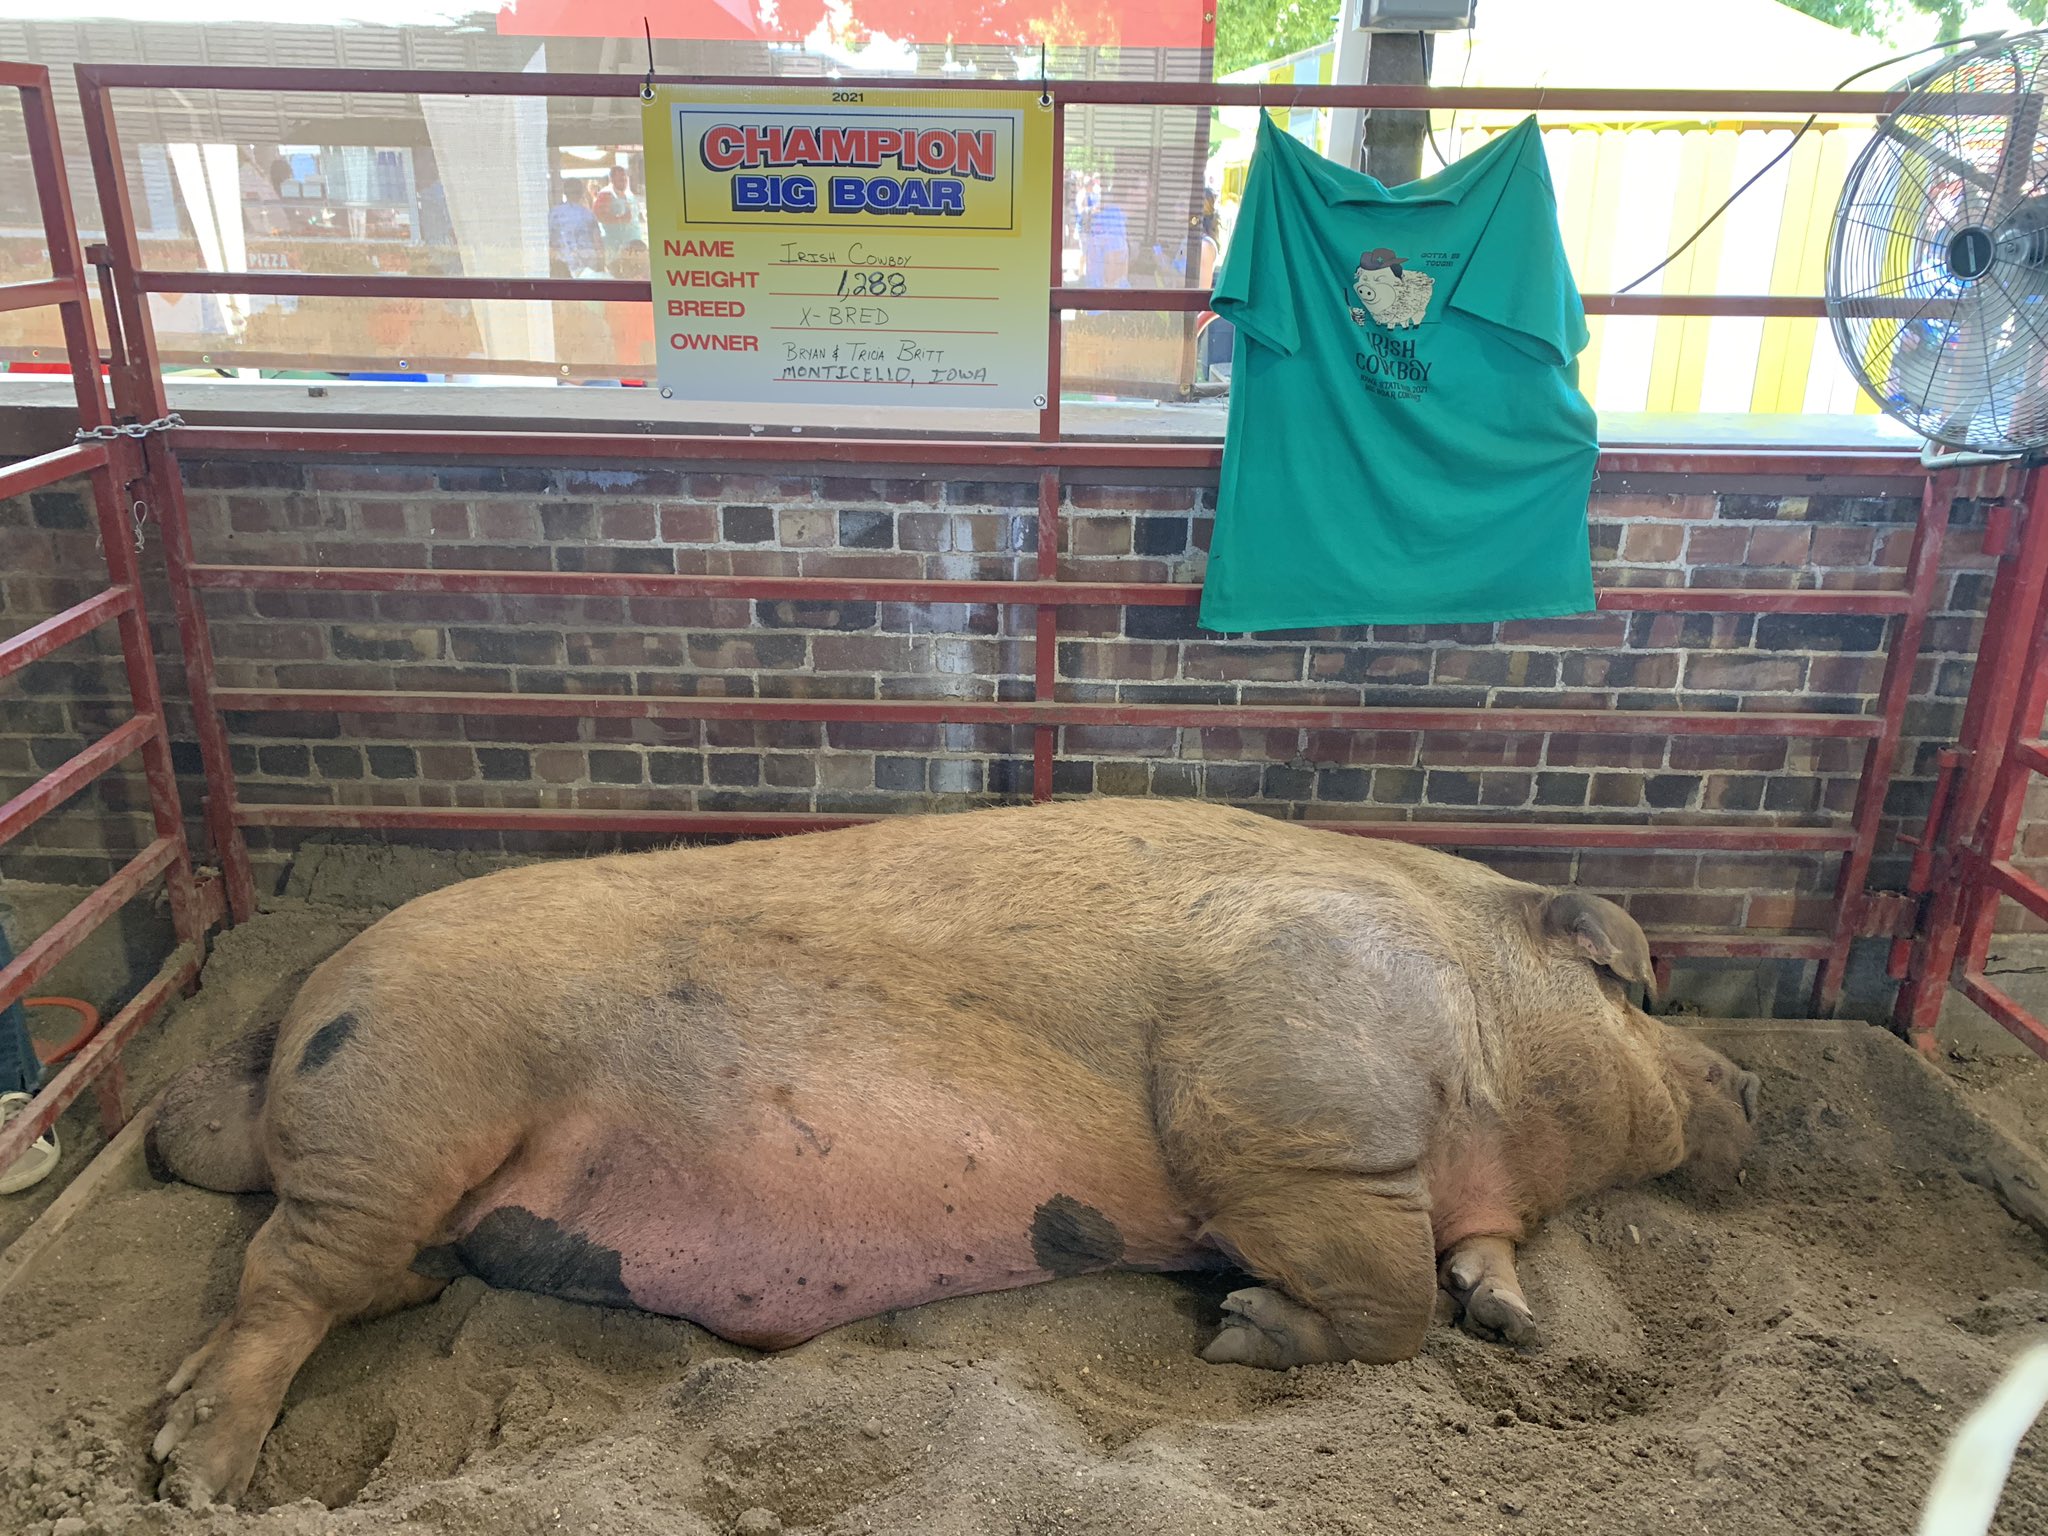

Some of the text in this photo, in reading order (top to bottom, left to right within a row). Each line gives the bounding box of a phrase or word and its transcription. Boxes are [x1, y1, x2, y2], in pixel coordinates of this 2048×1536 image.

[832, 92, 865, 102] 2021
[701, 124, 996, 181] CHAMPION
[731, 174, 965, 216] BIG BOAR
[664, 240, 735, 258] NAME
[248, 252, 289, 269] PIZZA
[666, 270, 760, 289] WEIGHT
[837, 270, 907, 302] 1,288
[668, 300, 746, 318] BREED
[670, 333, 759, 352] OWNER
